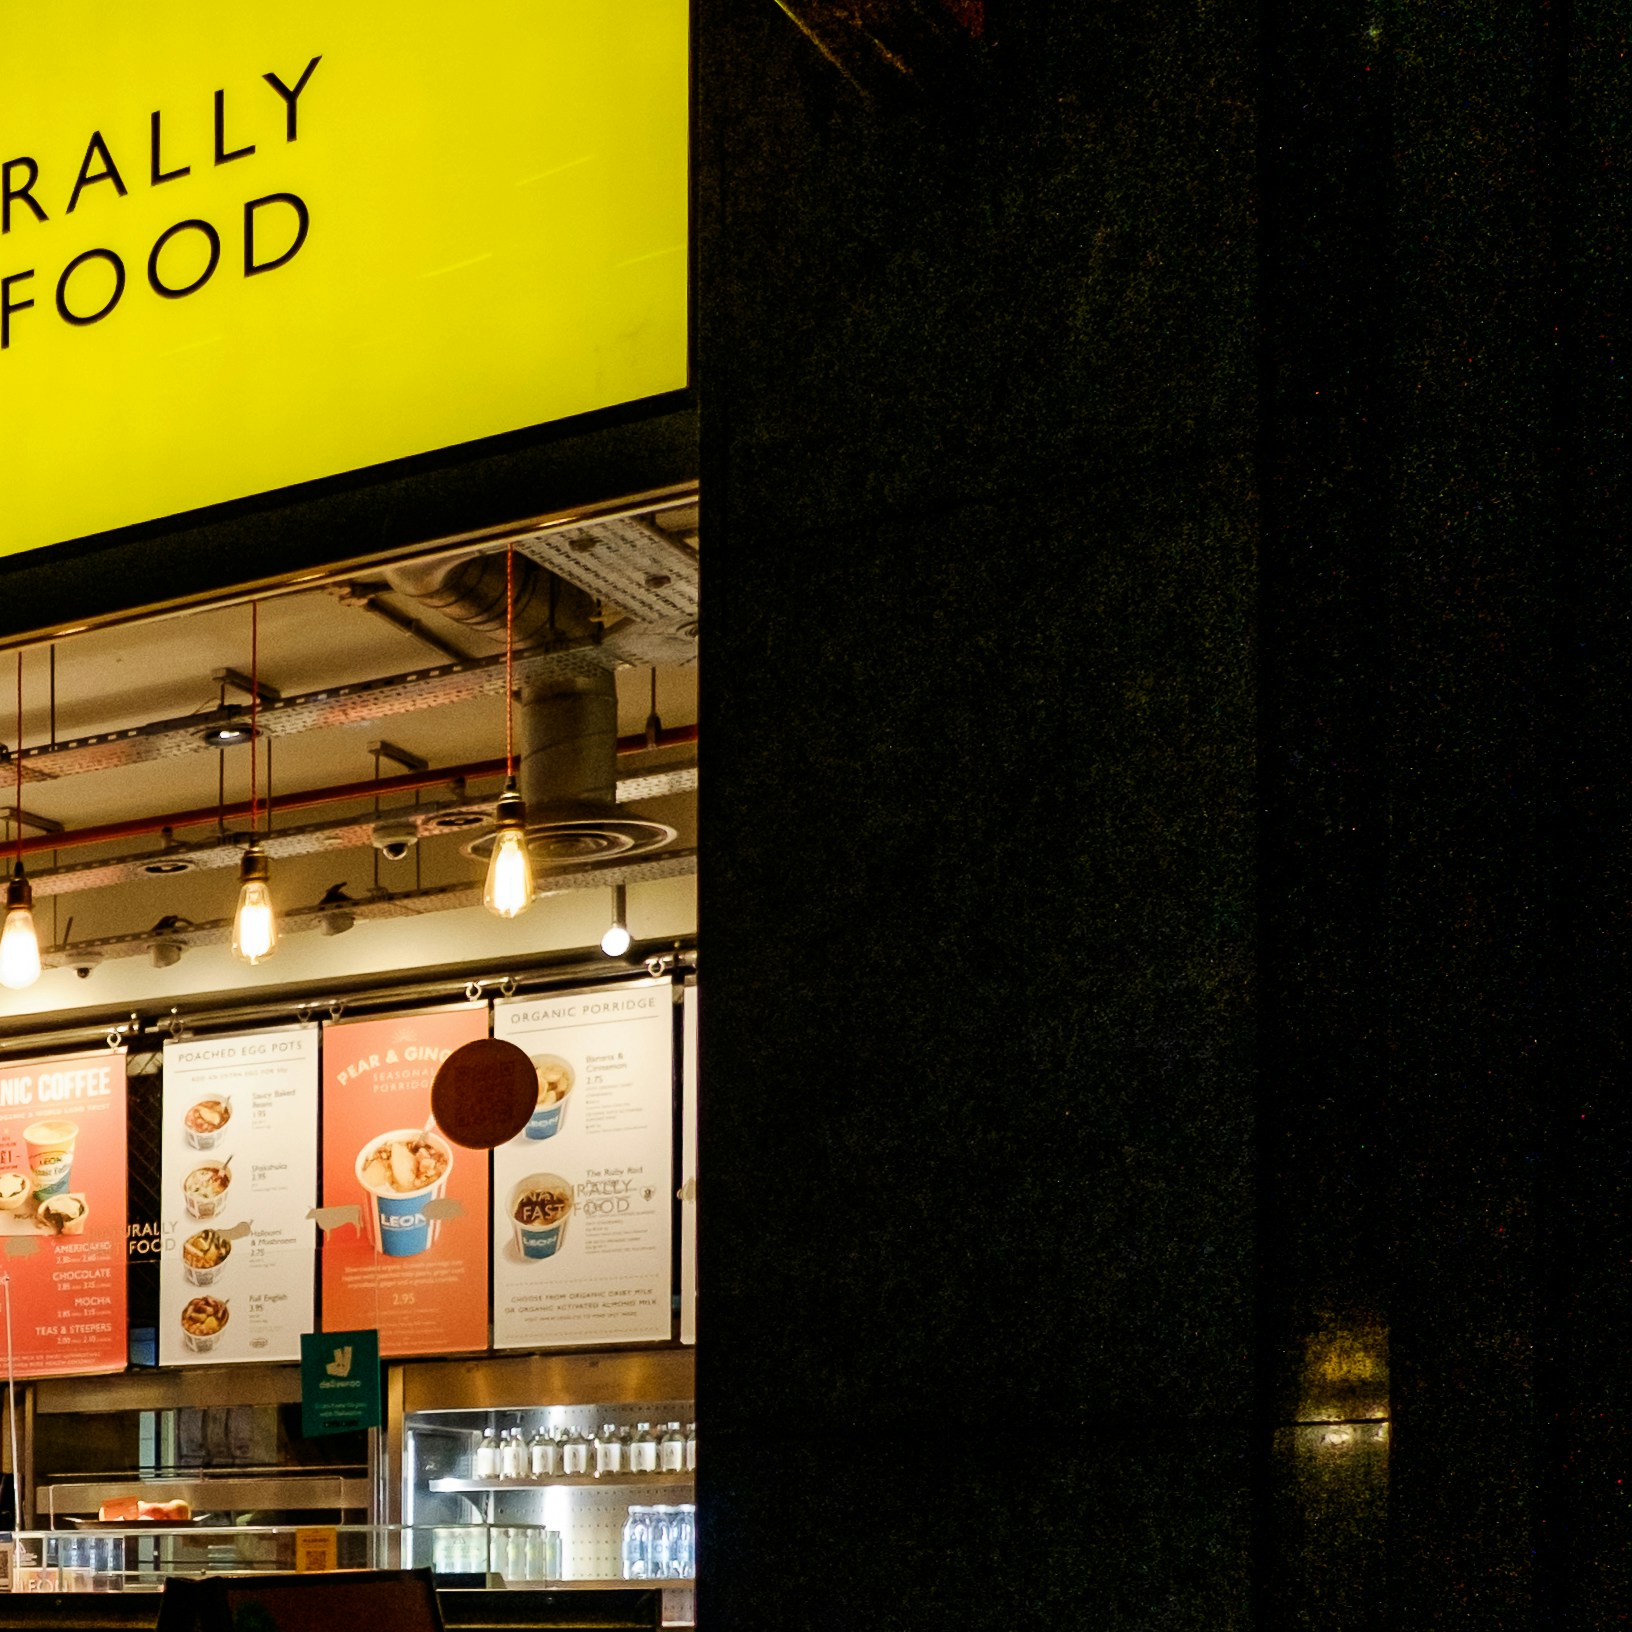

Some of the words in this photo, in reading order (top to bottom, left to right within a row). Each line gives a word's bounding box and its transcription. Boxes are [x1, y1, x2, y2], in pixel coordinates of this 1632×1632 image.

[0, 191, 310, 351] FOOD
[511, 1006, 577, 1024] ORGANIC
[582, 996, 656, 1014] PORRIDGE
[178, 1048, 236, 1063] POACHED
[241, 1044, 266, 1057] EGG
[271, 1040, 303, 1053] POTS
[336, 1054, 381, 1087] PEAR
[385, 1048, 399, 1064] &
[404, 1045, 453, 1064] GING
[38, 1066, 112, 1102] COFFEE
[372, 1079, 430, 1093] PORRIDG
[528, 1115, 559, 1128] EON
[523, 1203, 565, 1221] FAST
[573, 1198, 630, 1217] FOOD
[380, 1212, 427, 1228] LEON
[52, 1268, 112, 1281] CHOCOLATE
[74, 1296, 112, 1307] MOCHA
[392, 1293, 415, 1305] 2.95
[36, 1326, 58, 1336] TEAS
[69, 1323, 112, 1334] STEEPERS
